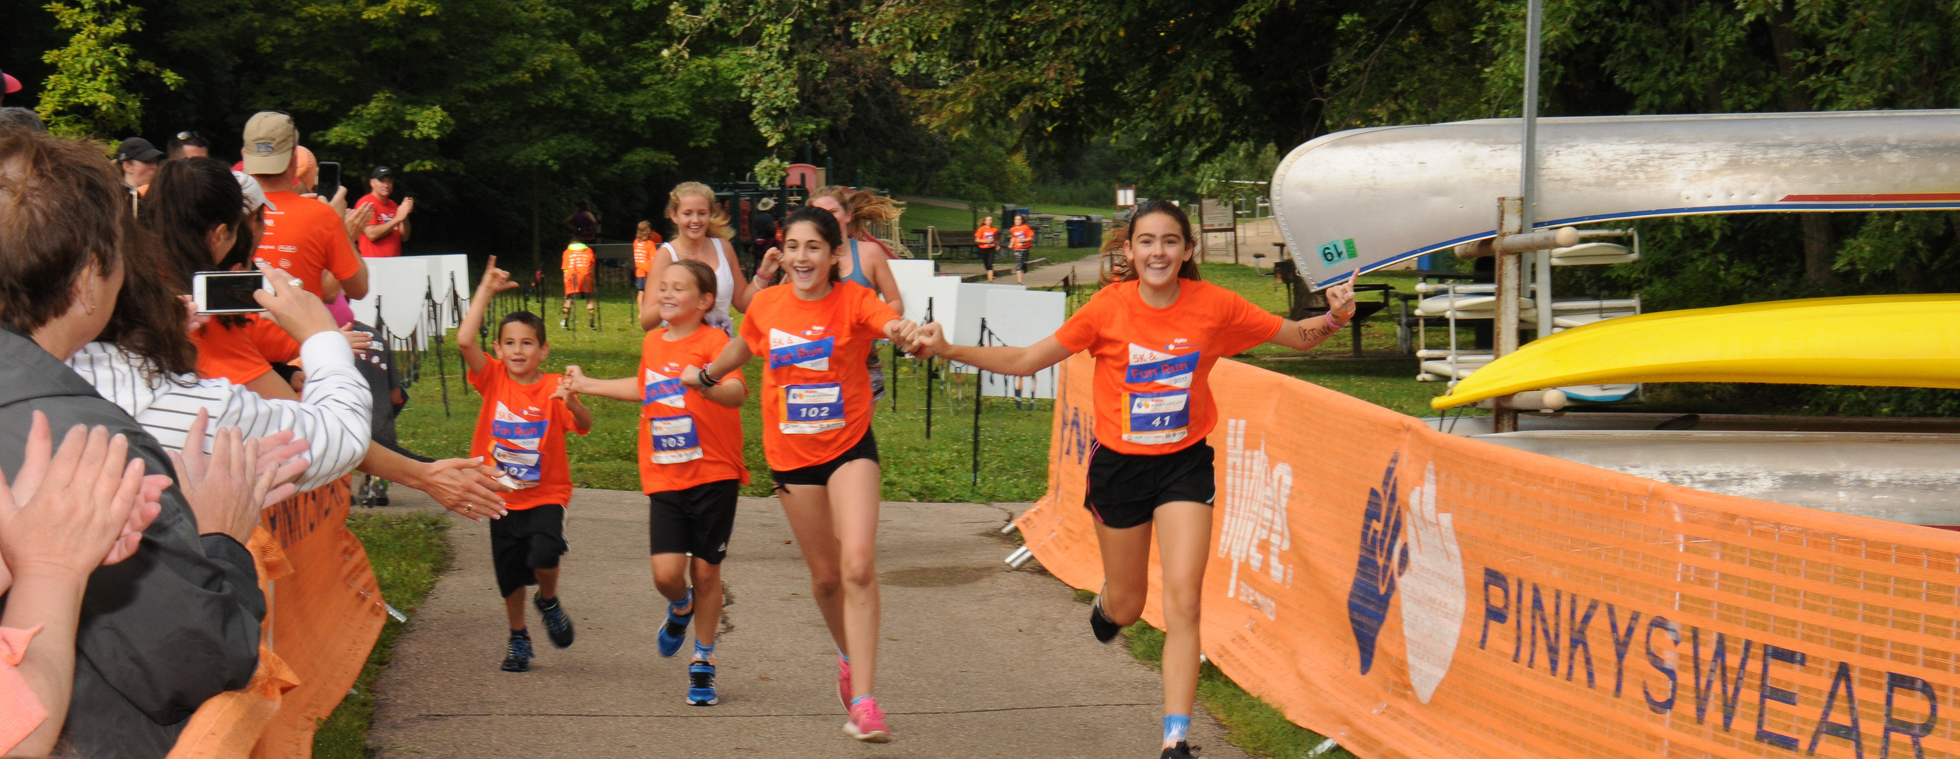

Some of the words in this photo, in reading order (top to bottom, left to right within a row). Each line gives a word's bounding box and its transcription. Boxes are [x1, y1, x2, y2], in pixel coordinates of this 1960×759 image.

[1322, 243, 1344, 262] 19
[771, 352, 796, 364] Fun
[797, 347, 824, 359] Run
[1132, 353, 1147, 363] 5K
[1131, 367, 1158, 379] Fun
[1161, 361, 1189, 375] Run
[799, 406, 830, 418] 102
[1151, 415, 1171, 427] 41
[514, 425, 538, 436] Run
[660, 436, 686, 448] 103
